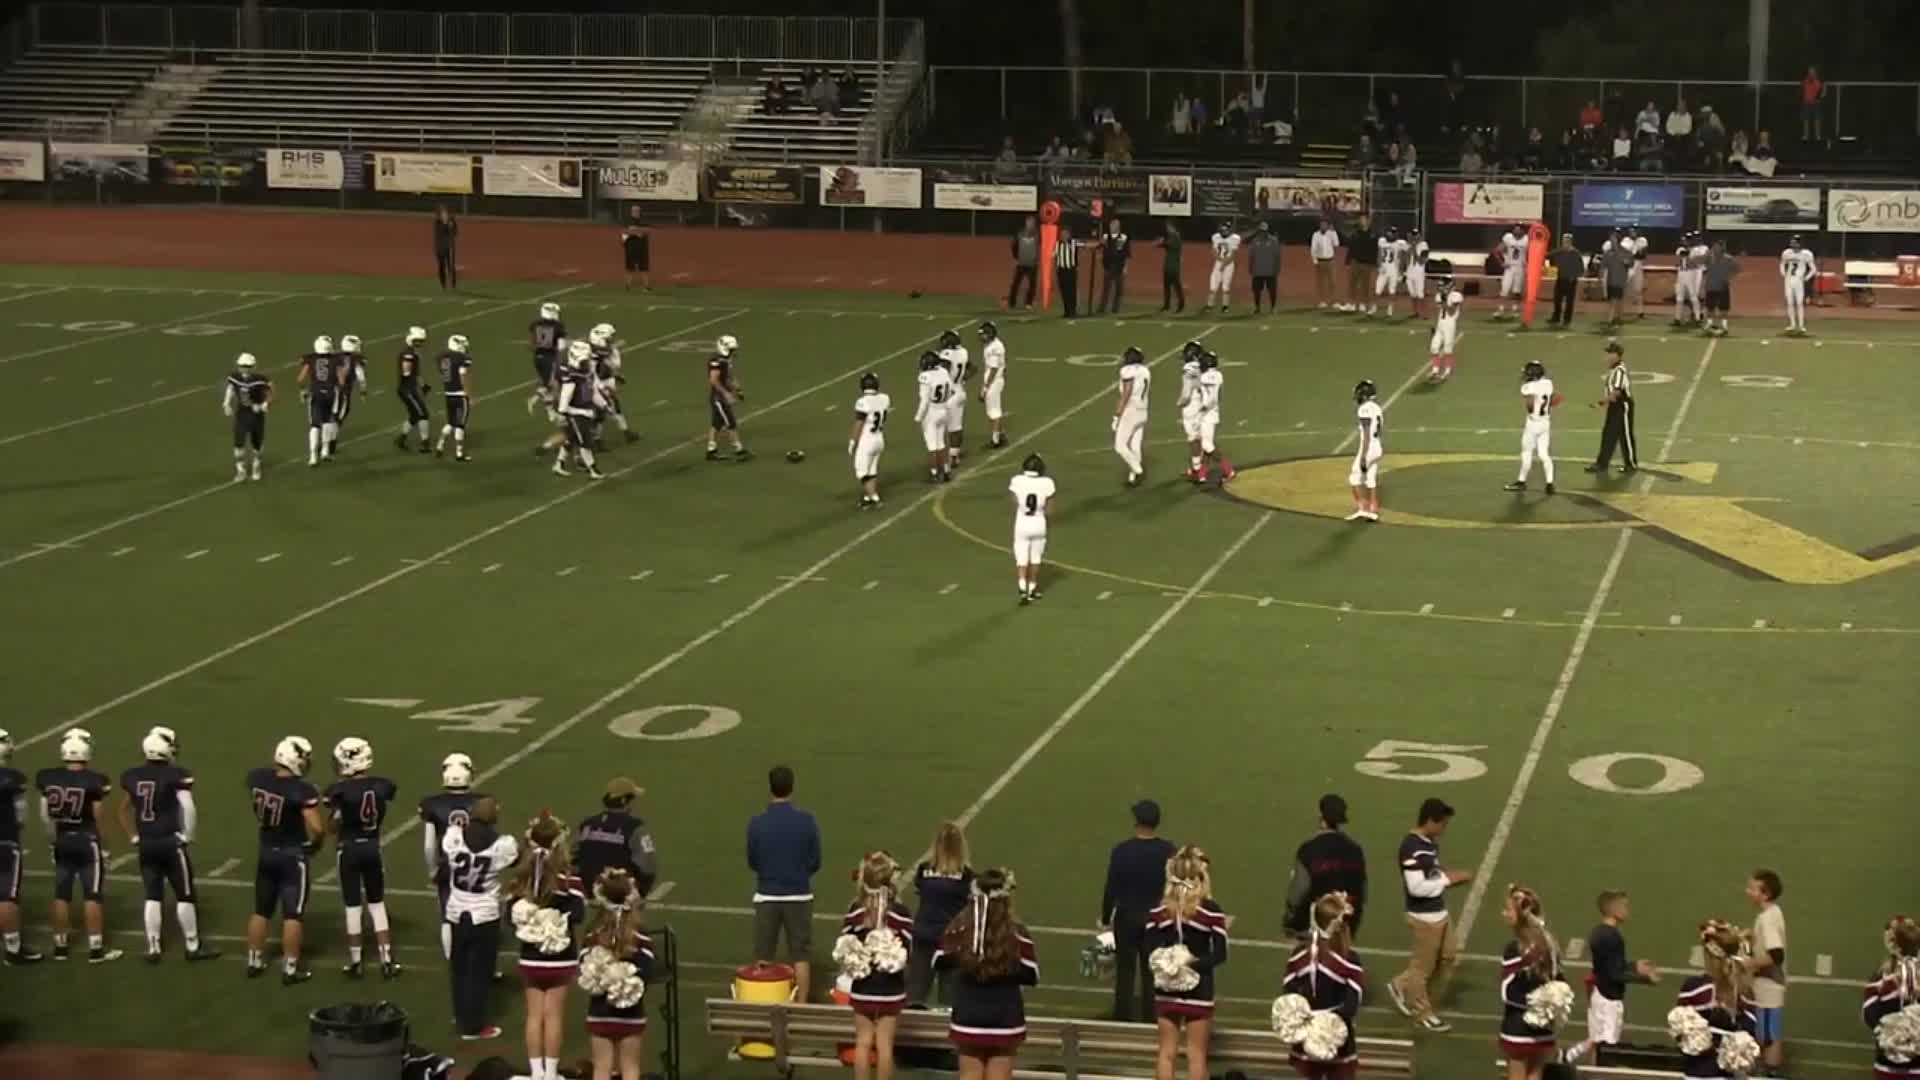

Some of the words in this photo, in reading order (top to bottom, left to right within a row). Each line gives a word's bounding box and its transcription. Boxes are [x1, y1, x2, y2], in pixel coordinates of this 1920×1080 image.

[281, 151, 325, 165] RHS
[1024, 492, 1038, 517] 9
[136, 780, 156, 822] 7
[358, 789, 379, 831] 4
[453, 851, 493, 894] 27
